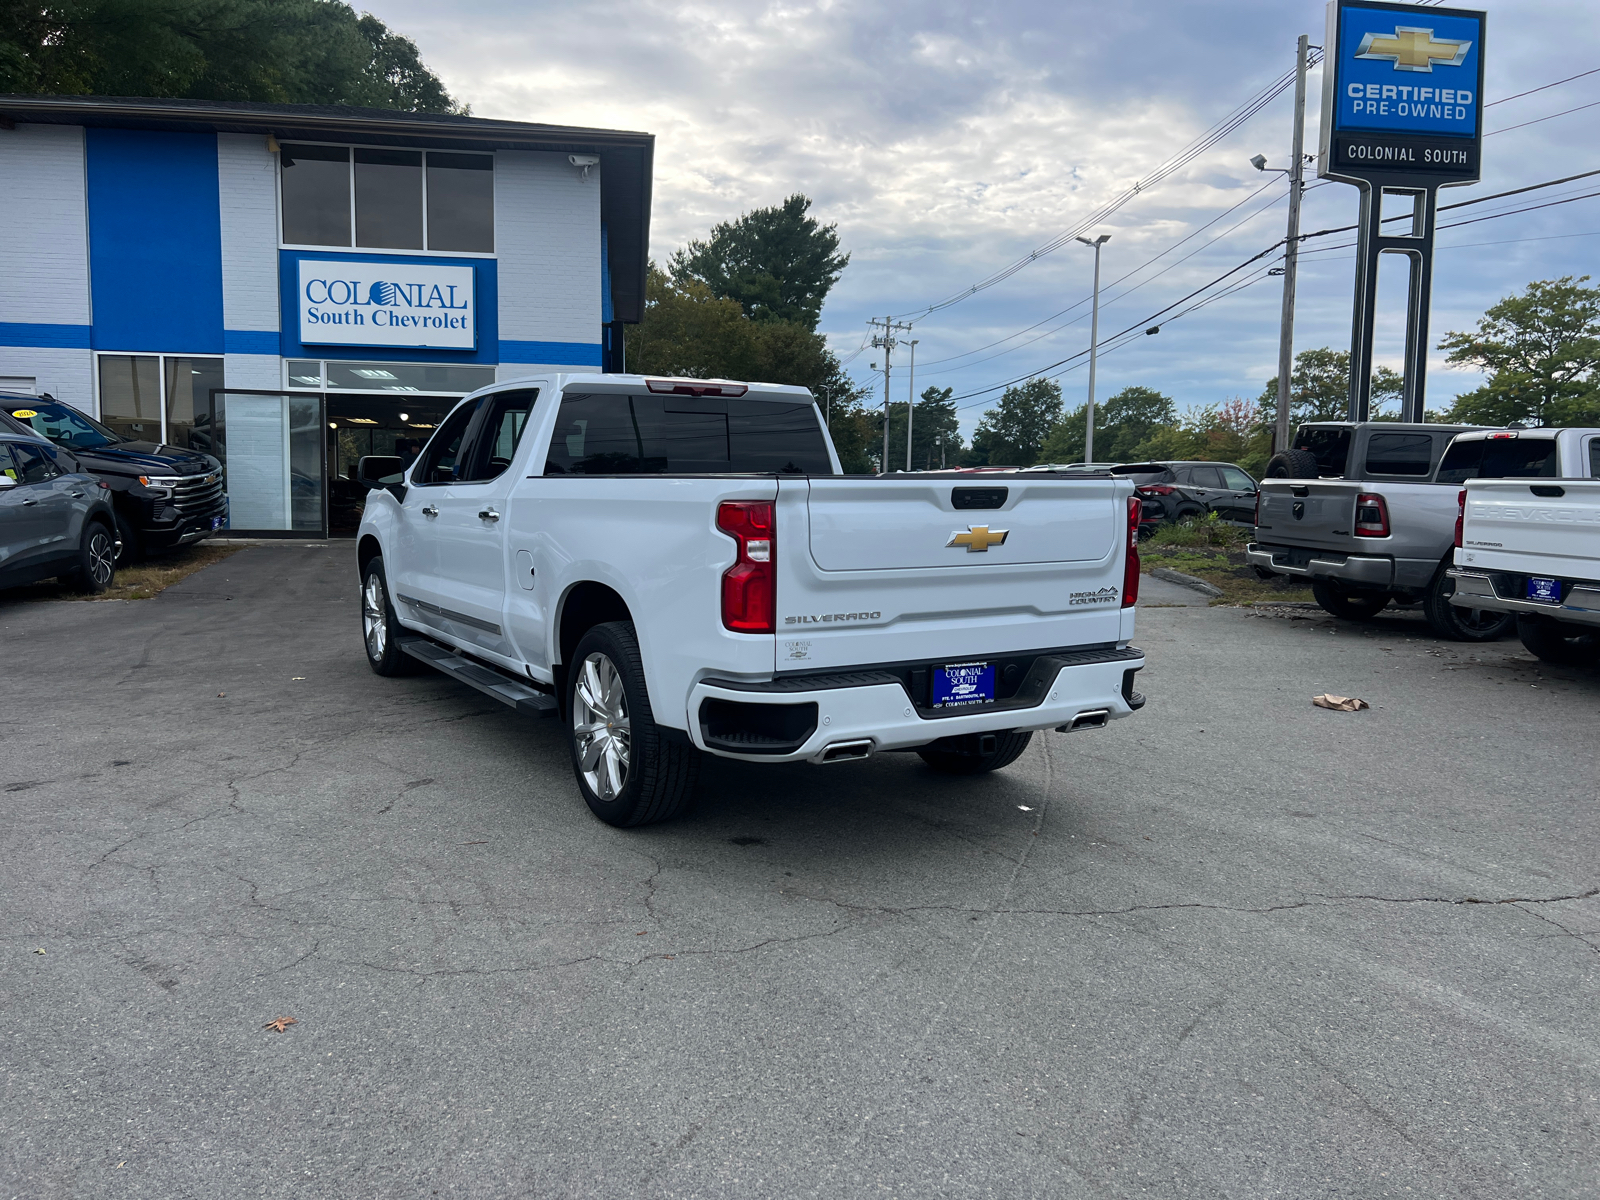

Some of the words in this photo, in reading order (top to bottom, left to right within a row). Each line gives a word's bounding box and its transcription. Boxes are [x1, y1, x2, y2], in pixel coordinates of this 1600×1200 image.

[1347, 83, 1473, 105] CERTIFIED
[1353, 100, 1466, 120] PRE-OWNED
[1348, 145, 1416, 161] COLONIAL
[1424, 149, 1467, 164] SOUTH
[306, 279, 468, 309] COLONIAL
[307, 307, 365, 325] South
[371, 309, 468, 329] Chevrolet
[1472, 506, 1600, 524] CHEVROL
[1466, 540, 1503, 548] SILVERADO
[1069, 596, 1117, 605] COUNTRY
[785, 611, 881, 624] SILVERADO
[945, 667, 984, 678] COLONIAL
[951, 675, 978, 685] SOUTH
